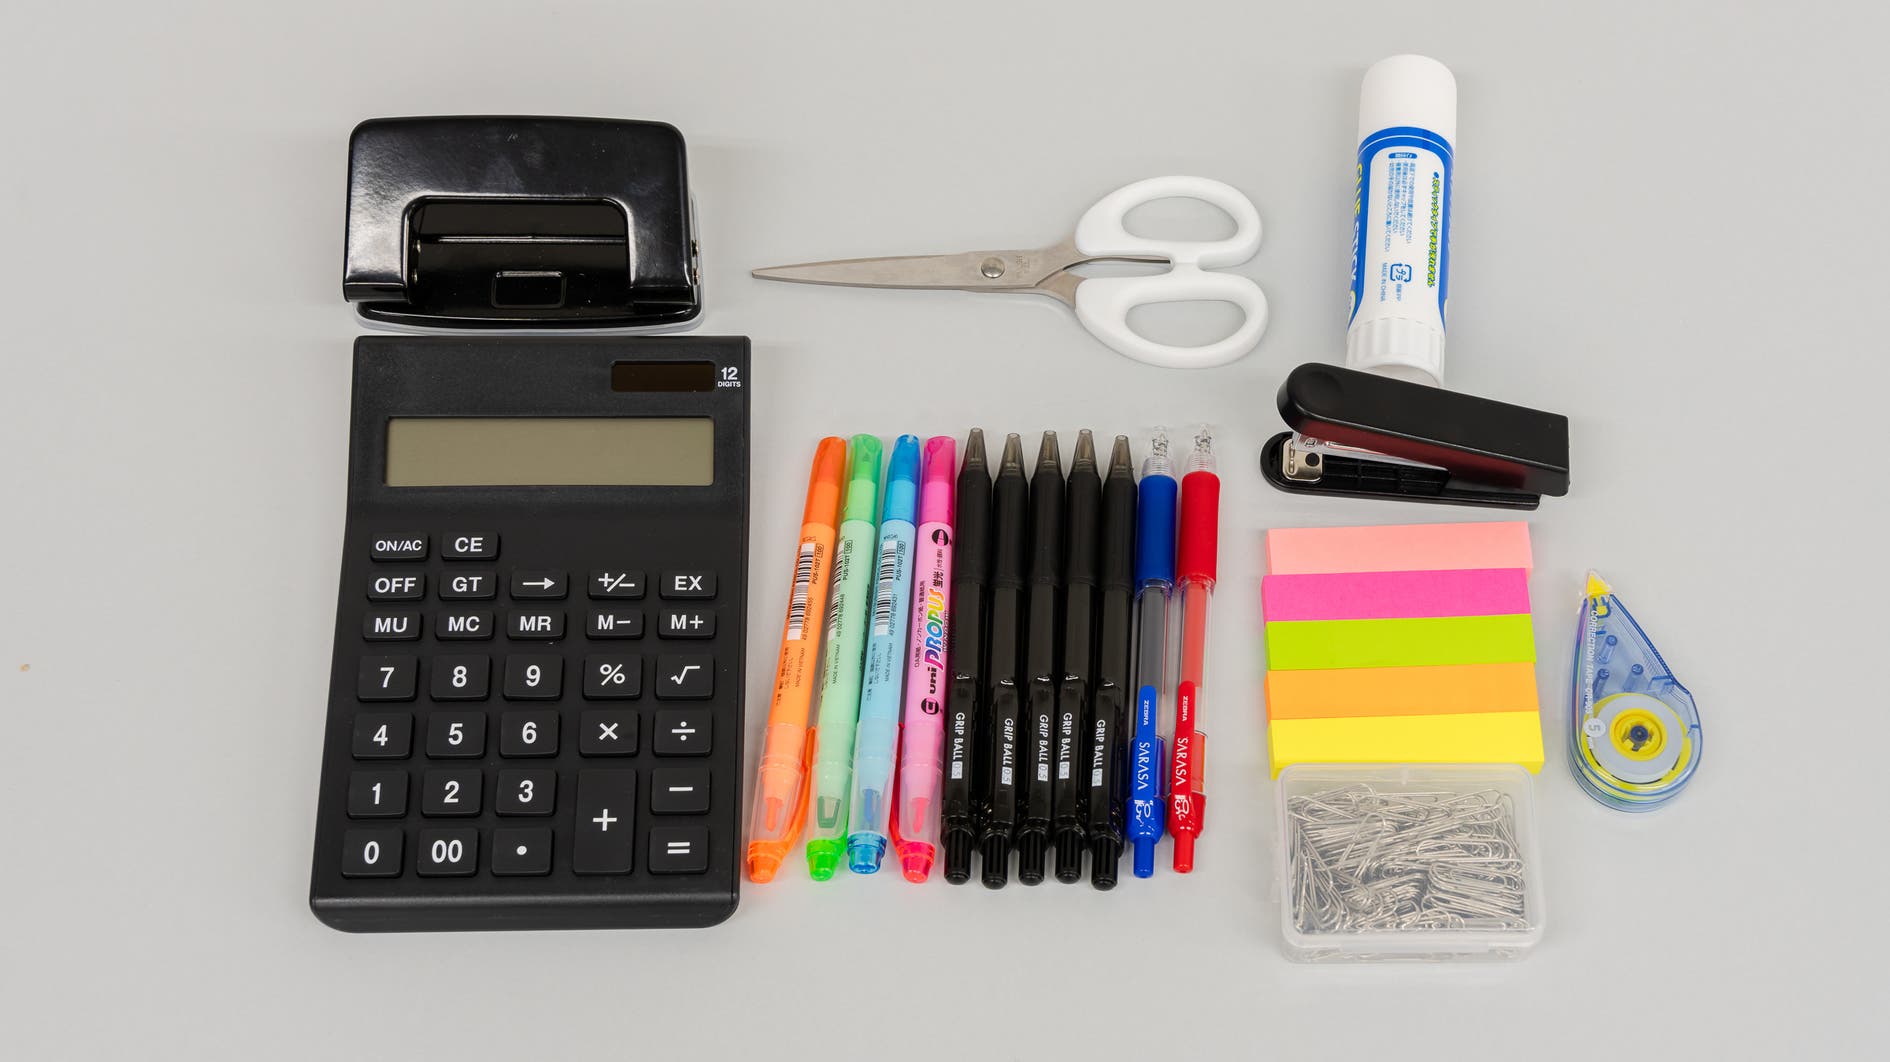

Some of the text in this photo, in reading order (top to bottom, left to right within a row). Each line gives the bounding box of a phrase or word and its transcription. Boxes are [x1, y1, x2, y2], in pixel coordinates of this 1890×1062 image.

[1395, 268, 1406, 281] プラ
[721, 367, 738, 380] 12
[376, 540, 422, 551] ON/AC
[455, 537, 483, 552] CE
[812, 558, 821, 584] PUS-102T
[933, 571, 944, 588] 蛍光
[375, 578, 416, 593] OFF
[453, 577, 482, 592] GT
[675, 576, 702, 590] EX
[806, 597, 814, 616] 692455
[375, 617, 407, 632] MU
[449, 616, 479, 631] MC
[520, 616, 551, 631] MR
[671, 615, 703, 629] M+
[924, 588, 945, 671] PROPUS
[1586, 610, 1598, 661] CORRECTION
[380, 667, 394, 687] 7
[453, 666, 466, 687] 8
[526, 665, 540, 686] 9
[600, 664, 625, 685] %
[927, 667, 937, 694] uni
[1585, 663, 1595, 684] TAPE
[449, 723, 463, 745] 5
[522, 722, 536, 744] 6
[954, 712, 965, 735] GRIP
[1004, 718, 1014, 741] GRIP
[1039, 714, 1049, 737] GRIP
[1062, 712, 1073, 736] GRIP
[1095, 719, 1106, 743] GRIP
[373, 725, 388, 746] 4
[953, 738, 963, 760] BALL
[1002, 743, 1013, 765] BALL
[1038, 740, 1048, 762] BALL
[1060, 738, 1071, 760] BALL
[1093, 745, 1104, 767] BALL
[1137, 742, 1150, 790] SARASA
[1175, 737, 1188, 786] SARASA
[372, 783, 380, 804] 1
[444, 781, 459, 803] 2
[519, 780, 533, 802] 3
[364, 841, 379, 864] 0
[432, 840, 462, 863] 00
